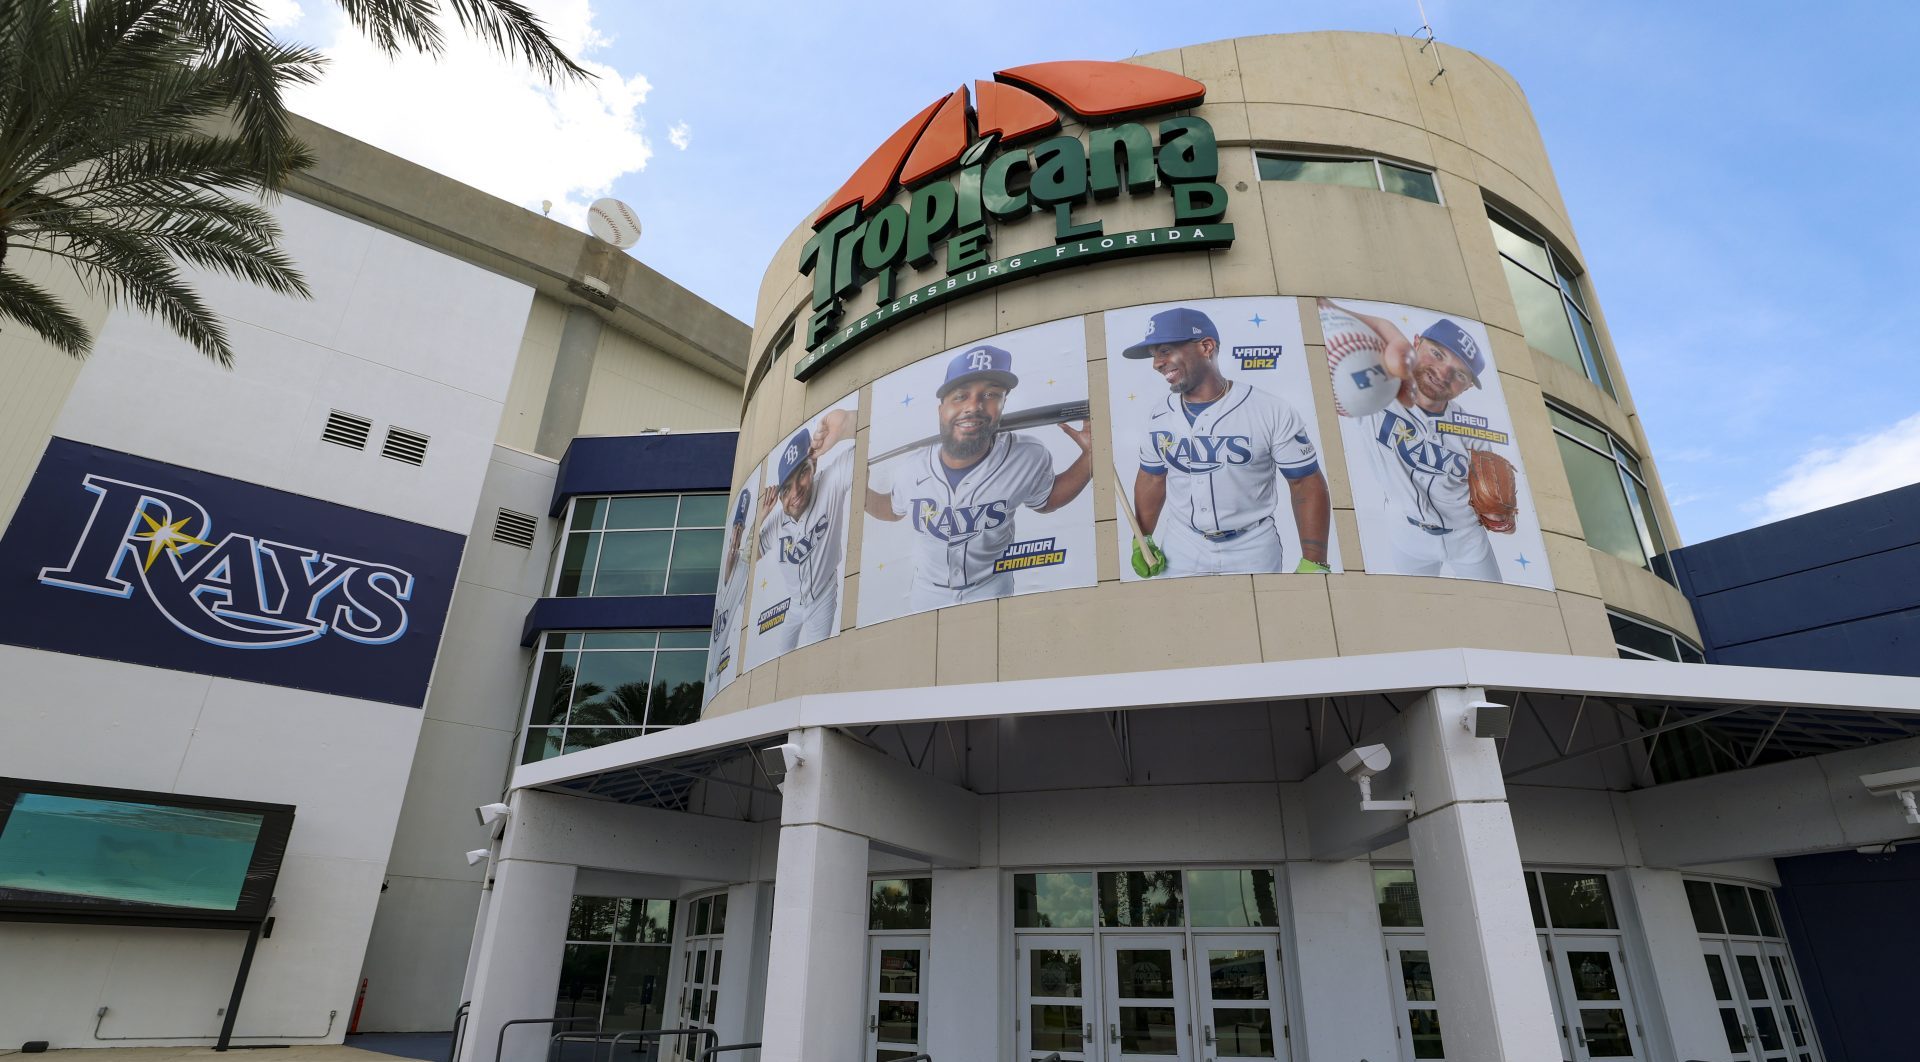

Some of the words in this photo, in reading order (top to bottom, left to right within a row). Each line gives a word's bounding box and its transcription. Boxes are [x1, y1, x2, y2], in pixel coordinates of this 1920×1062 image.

[800, 116, 1218, 313] Tropicana
[808, 343, 836, 364] ST.
[1056, 228, 1205, 257] FLORIDA
[1235, 347, 1280, 357] YANDY
[1243, 356, 1275, 368] DÍAZ
[1437, 422, 1508, 443] RASMUSSEN
[1454, 413, 1487, 427] DREW
[1150, 430, 1253, 473] RAYS
[1376, 408, 1468, 480] RAYS
[779, 514, 829, 565] RAYS
[910, 498, 1008, 546] RAYS
[37, 473, 415, 650] RAYS
[994, 551, 1064, 572] CAMINERO
[1005, 540, 1053, 557] JUNIOR
